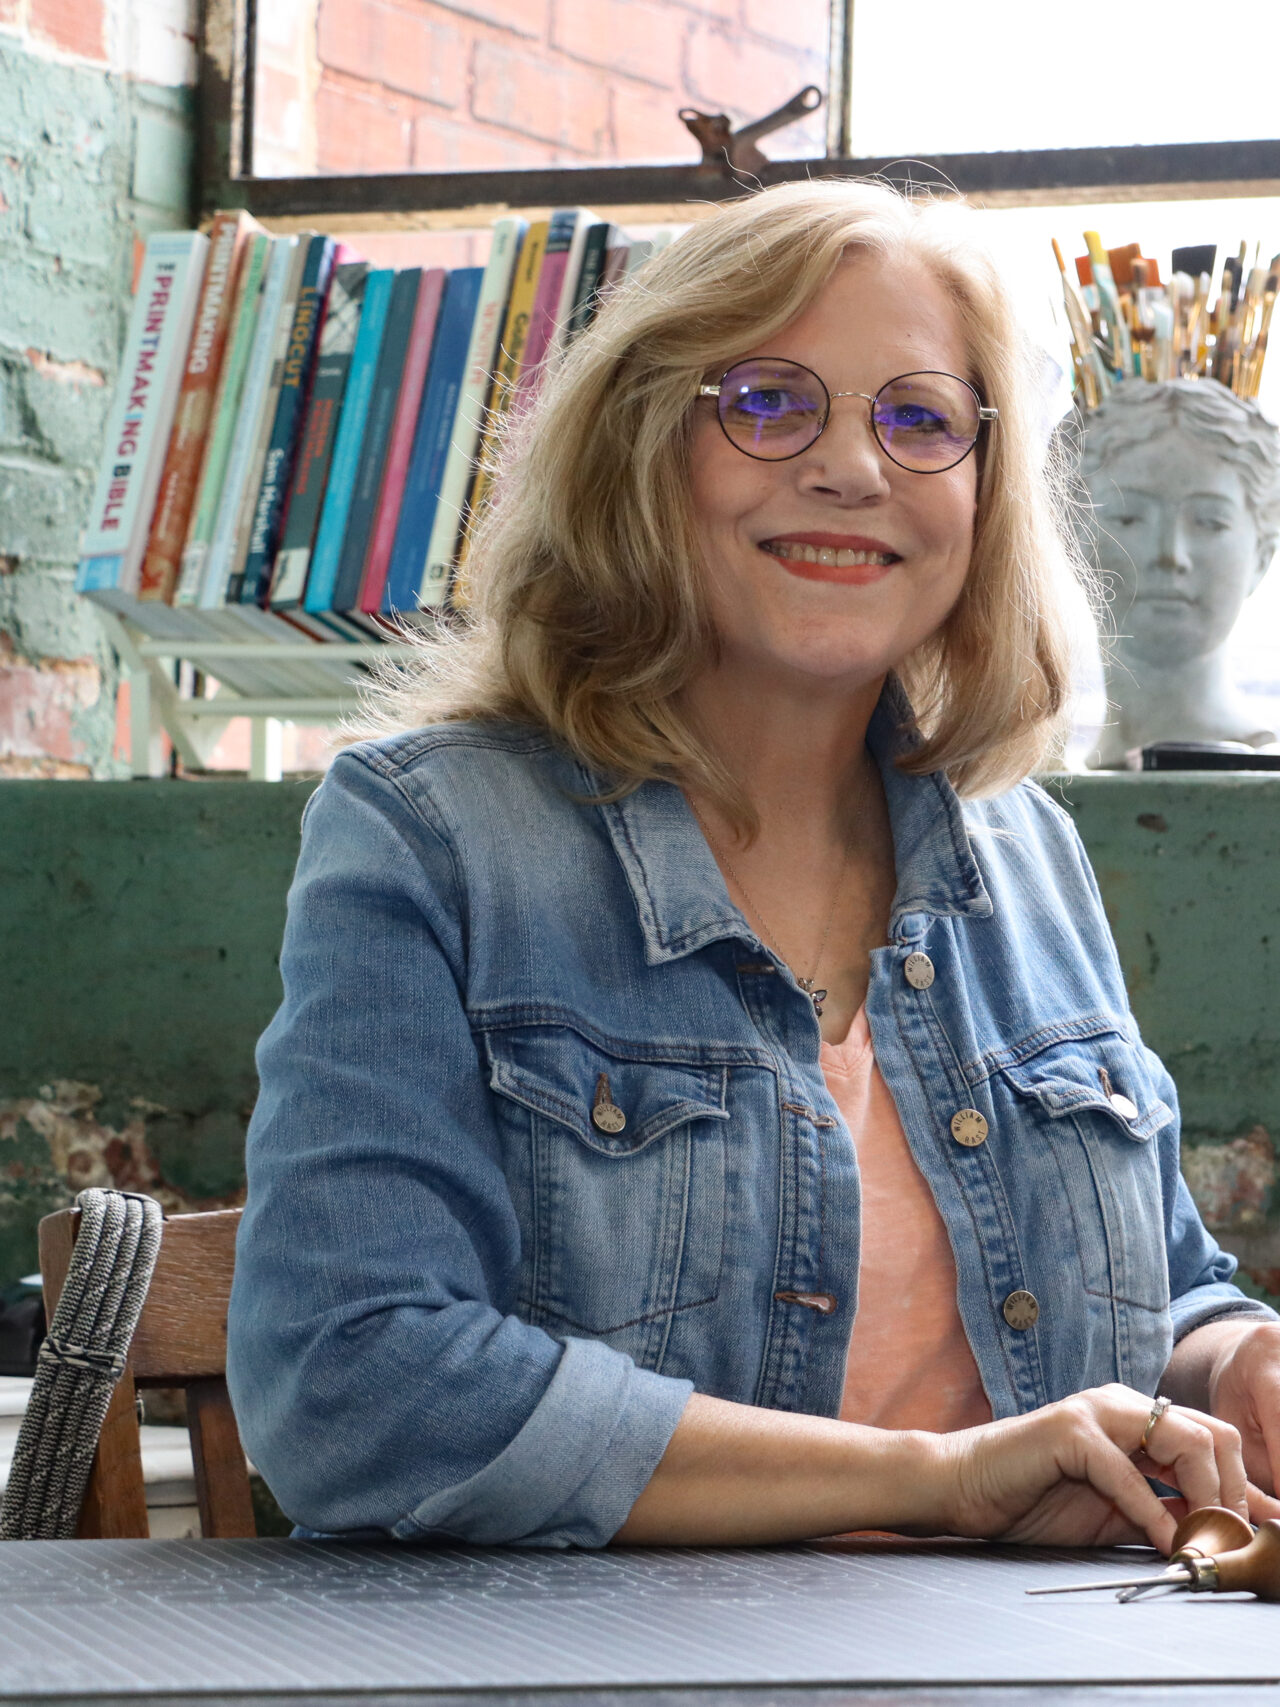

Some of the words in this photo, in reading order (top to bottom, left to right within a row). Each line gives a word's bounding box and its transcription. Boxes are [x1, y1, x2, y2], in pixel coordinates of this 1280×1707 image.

[188, 222, 237, 374] PRINTMAKING
[118, 275, 174, 457] PRINTMAKING
[284, 287, 316, 388] LINOCUT
[100, 463, 132, 532] BIBLE
[264, 447, 285, 484] Sam
[251, 485, 277, 554] Marshall
[953, 1111, 983, 1132] WILLIAM
[964, 1130, 985, 1145] RAST
